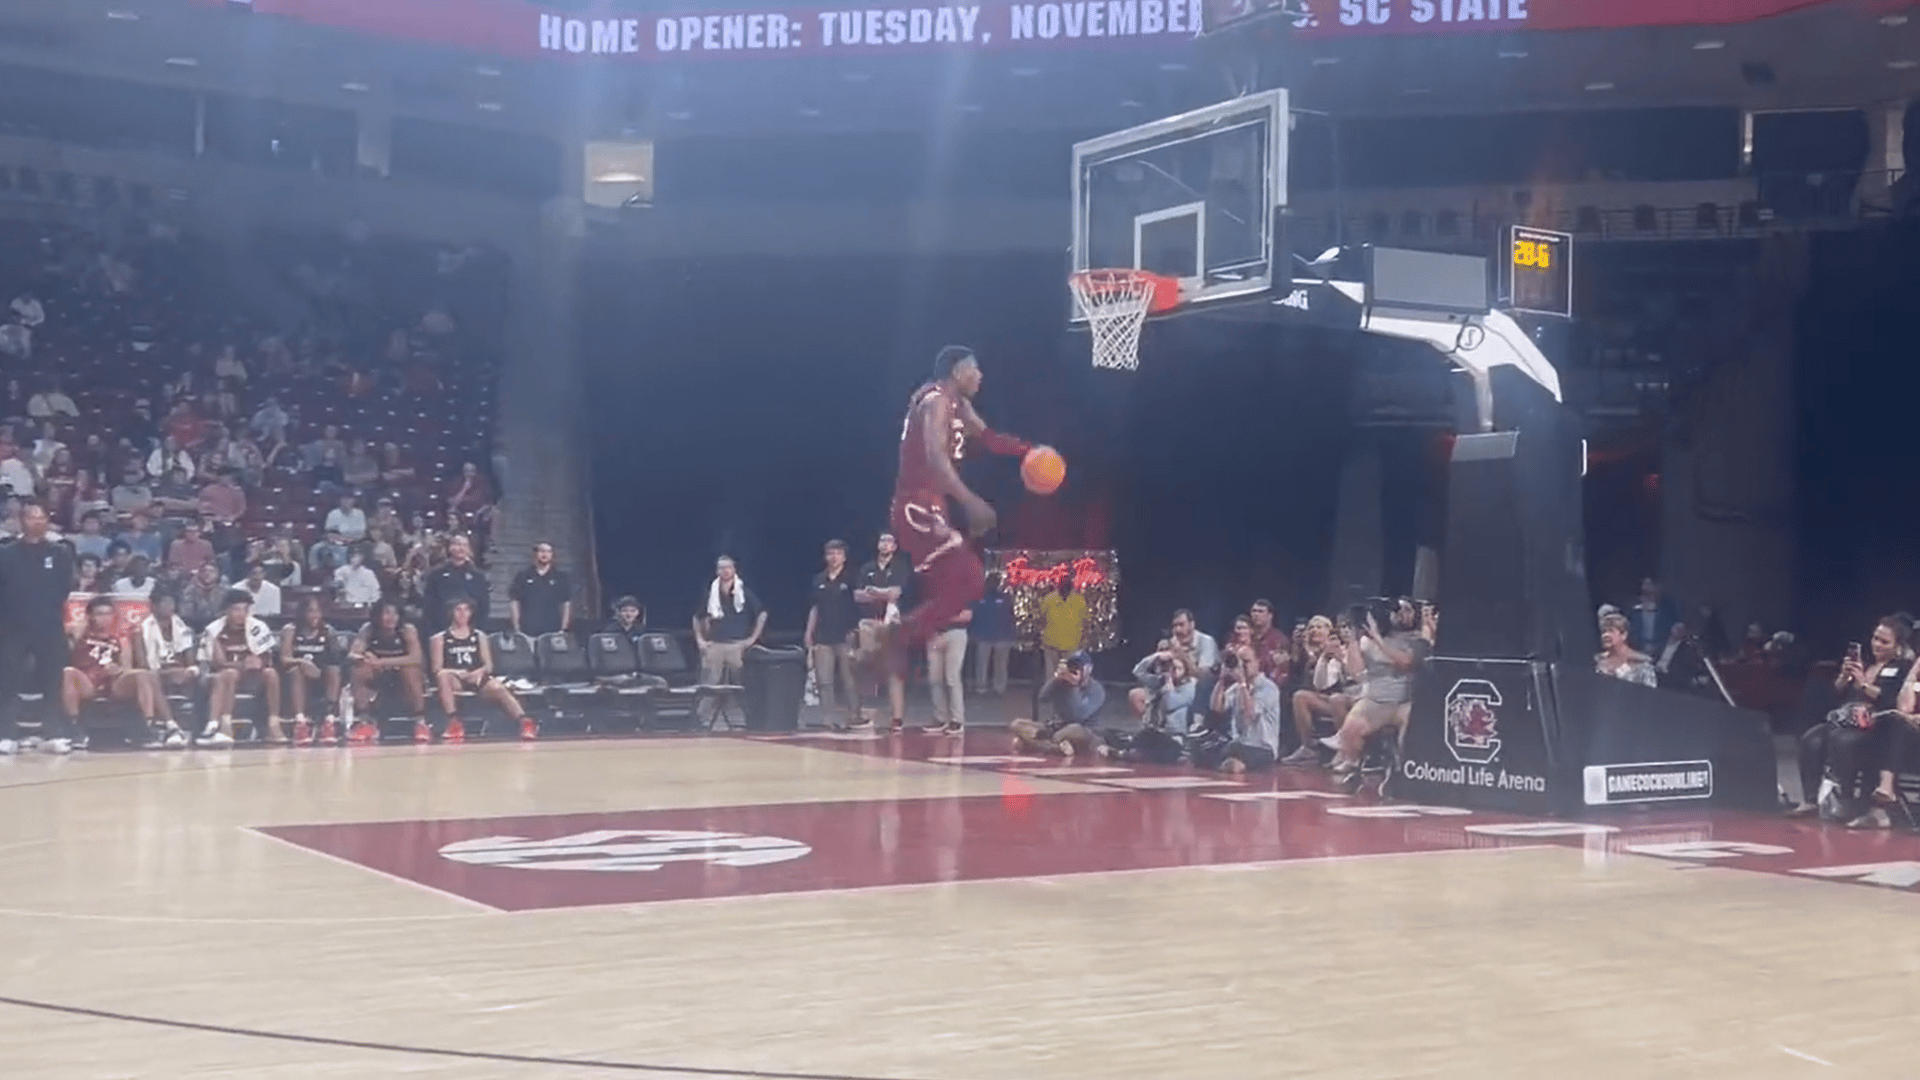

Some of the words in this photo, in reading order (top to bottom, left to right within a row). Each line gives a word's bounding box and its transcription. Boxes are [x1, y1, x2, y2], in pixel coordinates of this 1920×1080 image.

[540, 13, 639, 52] HOME
[656, 14, 802, 50] OPENER:
[819, 5, 991, 45] TUESDAY,
[1340, 0, 1391, 25] SC
[1411, 0, 1527, 23] STATE
[1404, 760, 1465, 785] Colonial
[1468, 766, 1495, 787] Life
[1498, 768, 1546, 792] Arena
